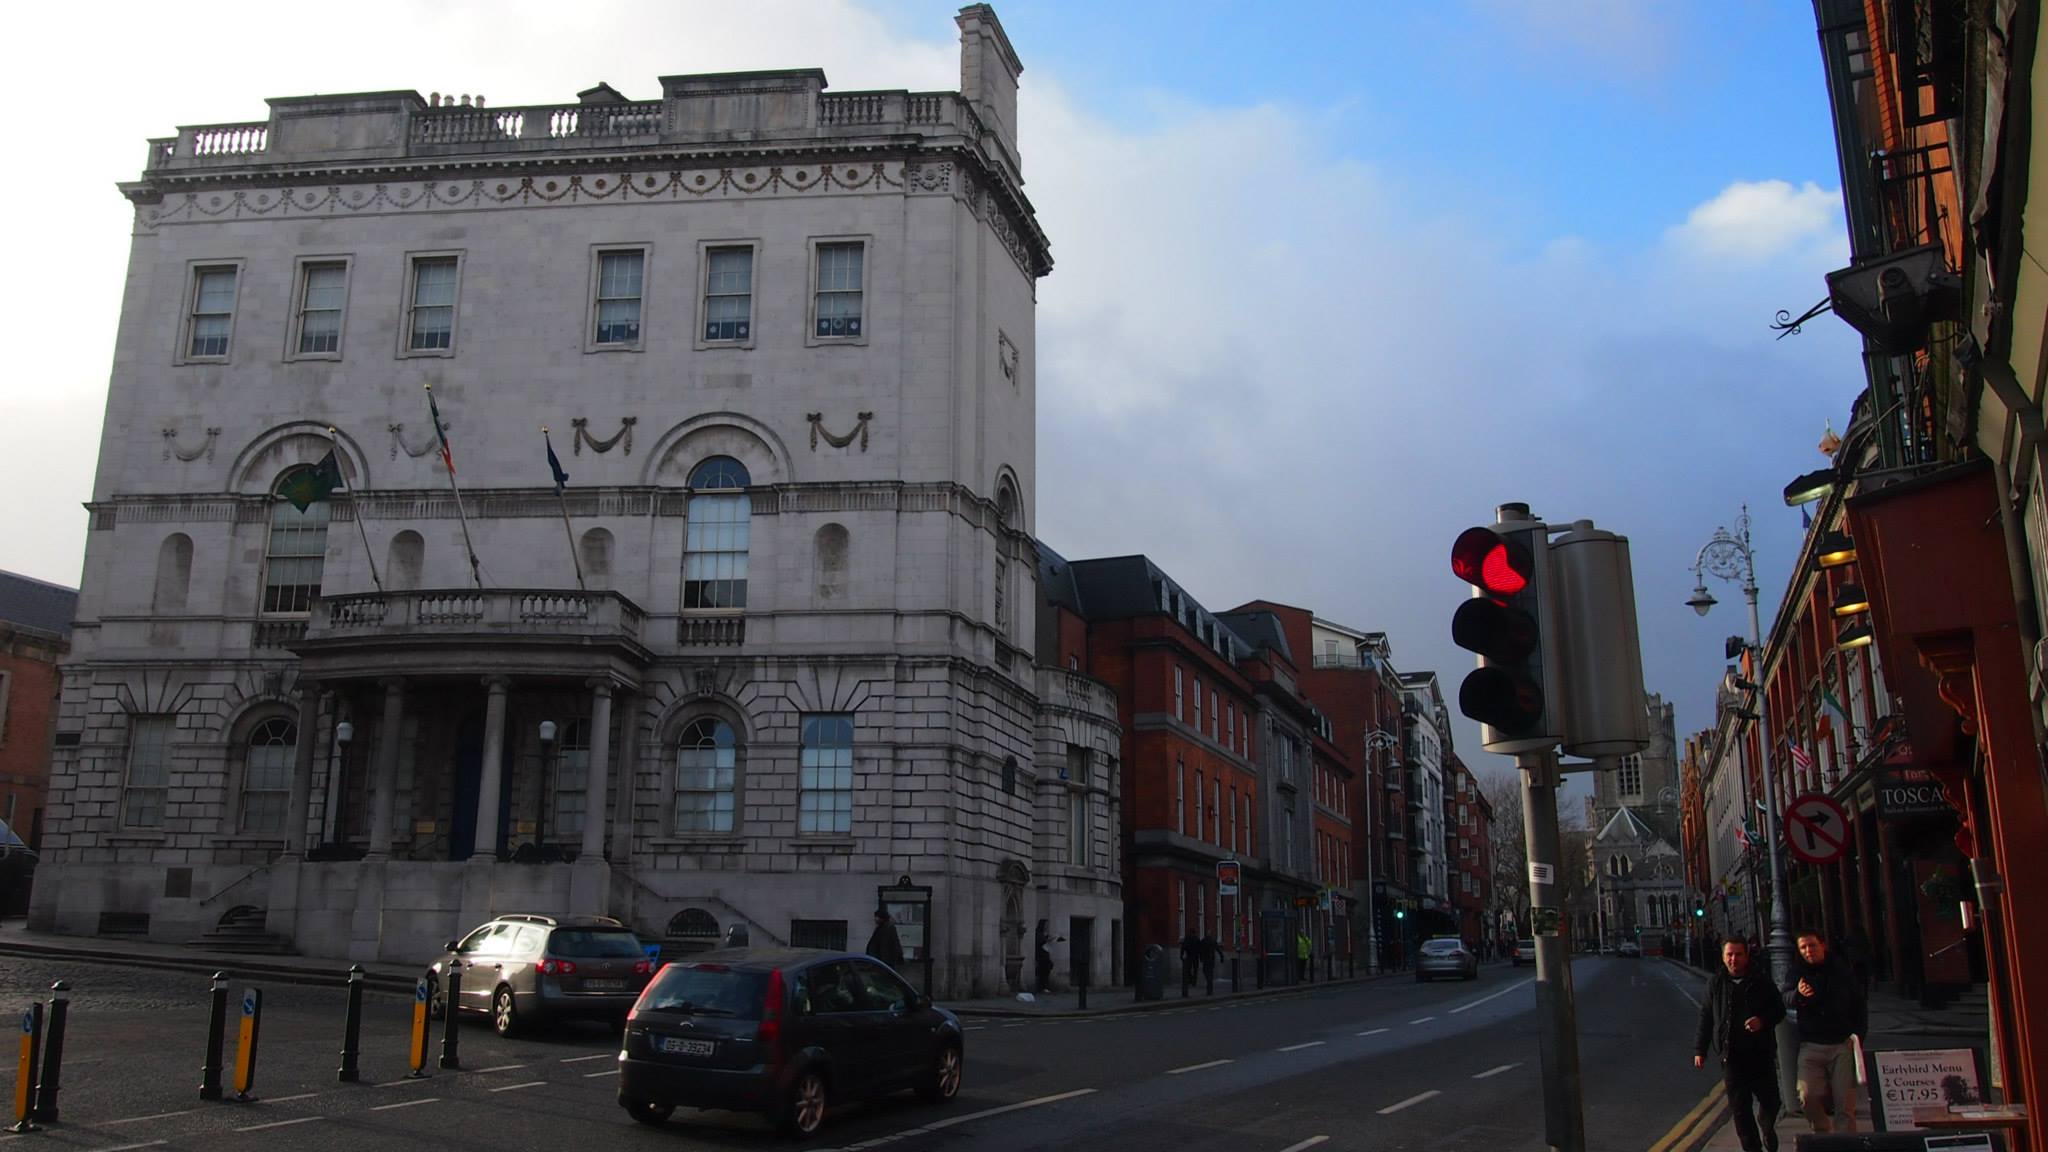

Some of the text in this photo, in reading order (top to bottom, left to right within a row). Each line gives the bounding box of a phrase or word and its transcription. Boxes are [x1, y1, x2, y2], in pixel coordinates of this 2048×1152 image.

[1881, 786, 1943, 805] TOSCA
[1881, 1063, 1963, 1075] Earlybird Menu
[1884, 1077, 1936, 1087] 2 Courses
[1886, 1089, 1939, 1101] €17.95
